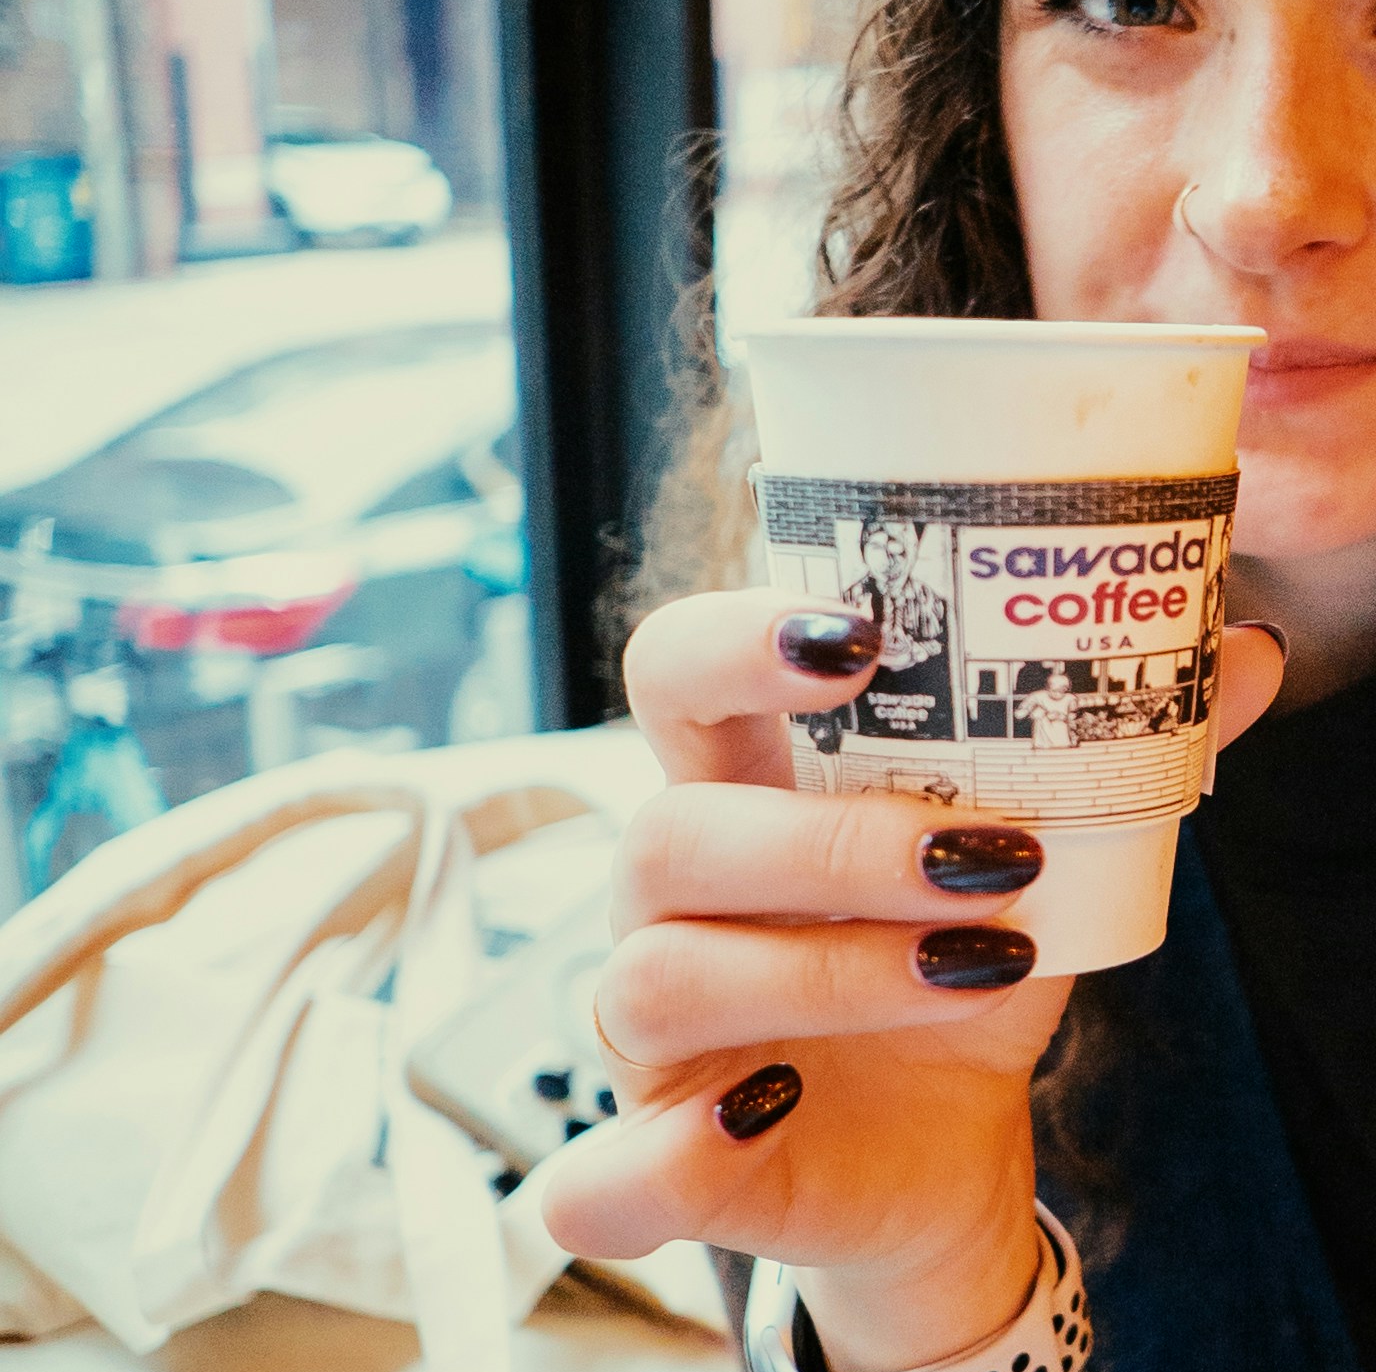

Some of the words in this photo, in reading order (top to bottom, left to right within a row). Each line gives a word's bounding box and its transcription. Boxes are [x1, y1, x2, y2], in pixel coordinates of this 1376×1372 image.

[969, 531, 1207, 578] sawada
[1004, 580, 1188, 626] coffee
[1076, 636, 1133, 651] USA
